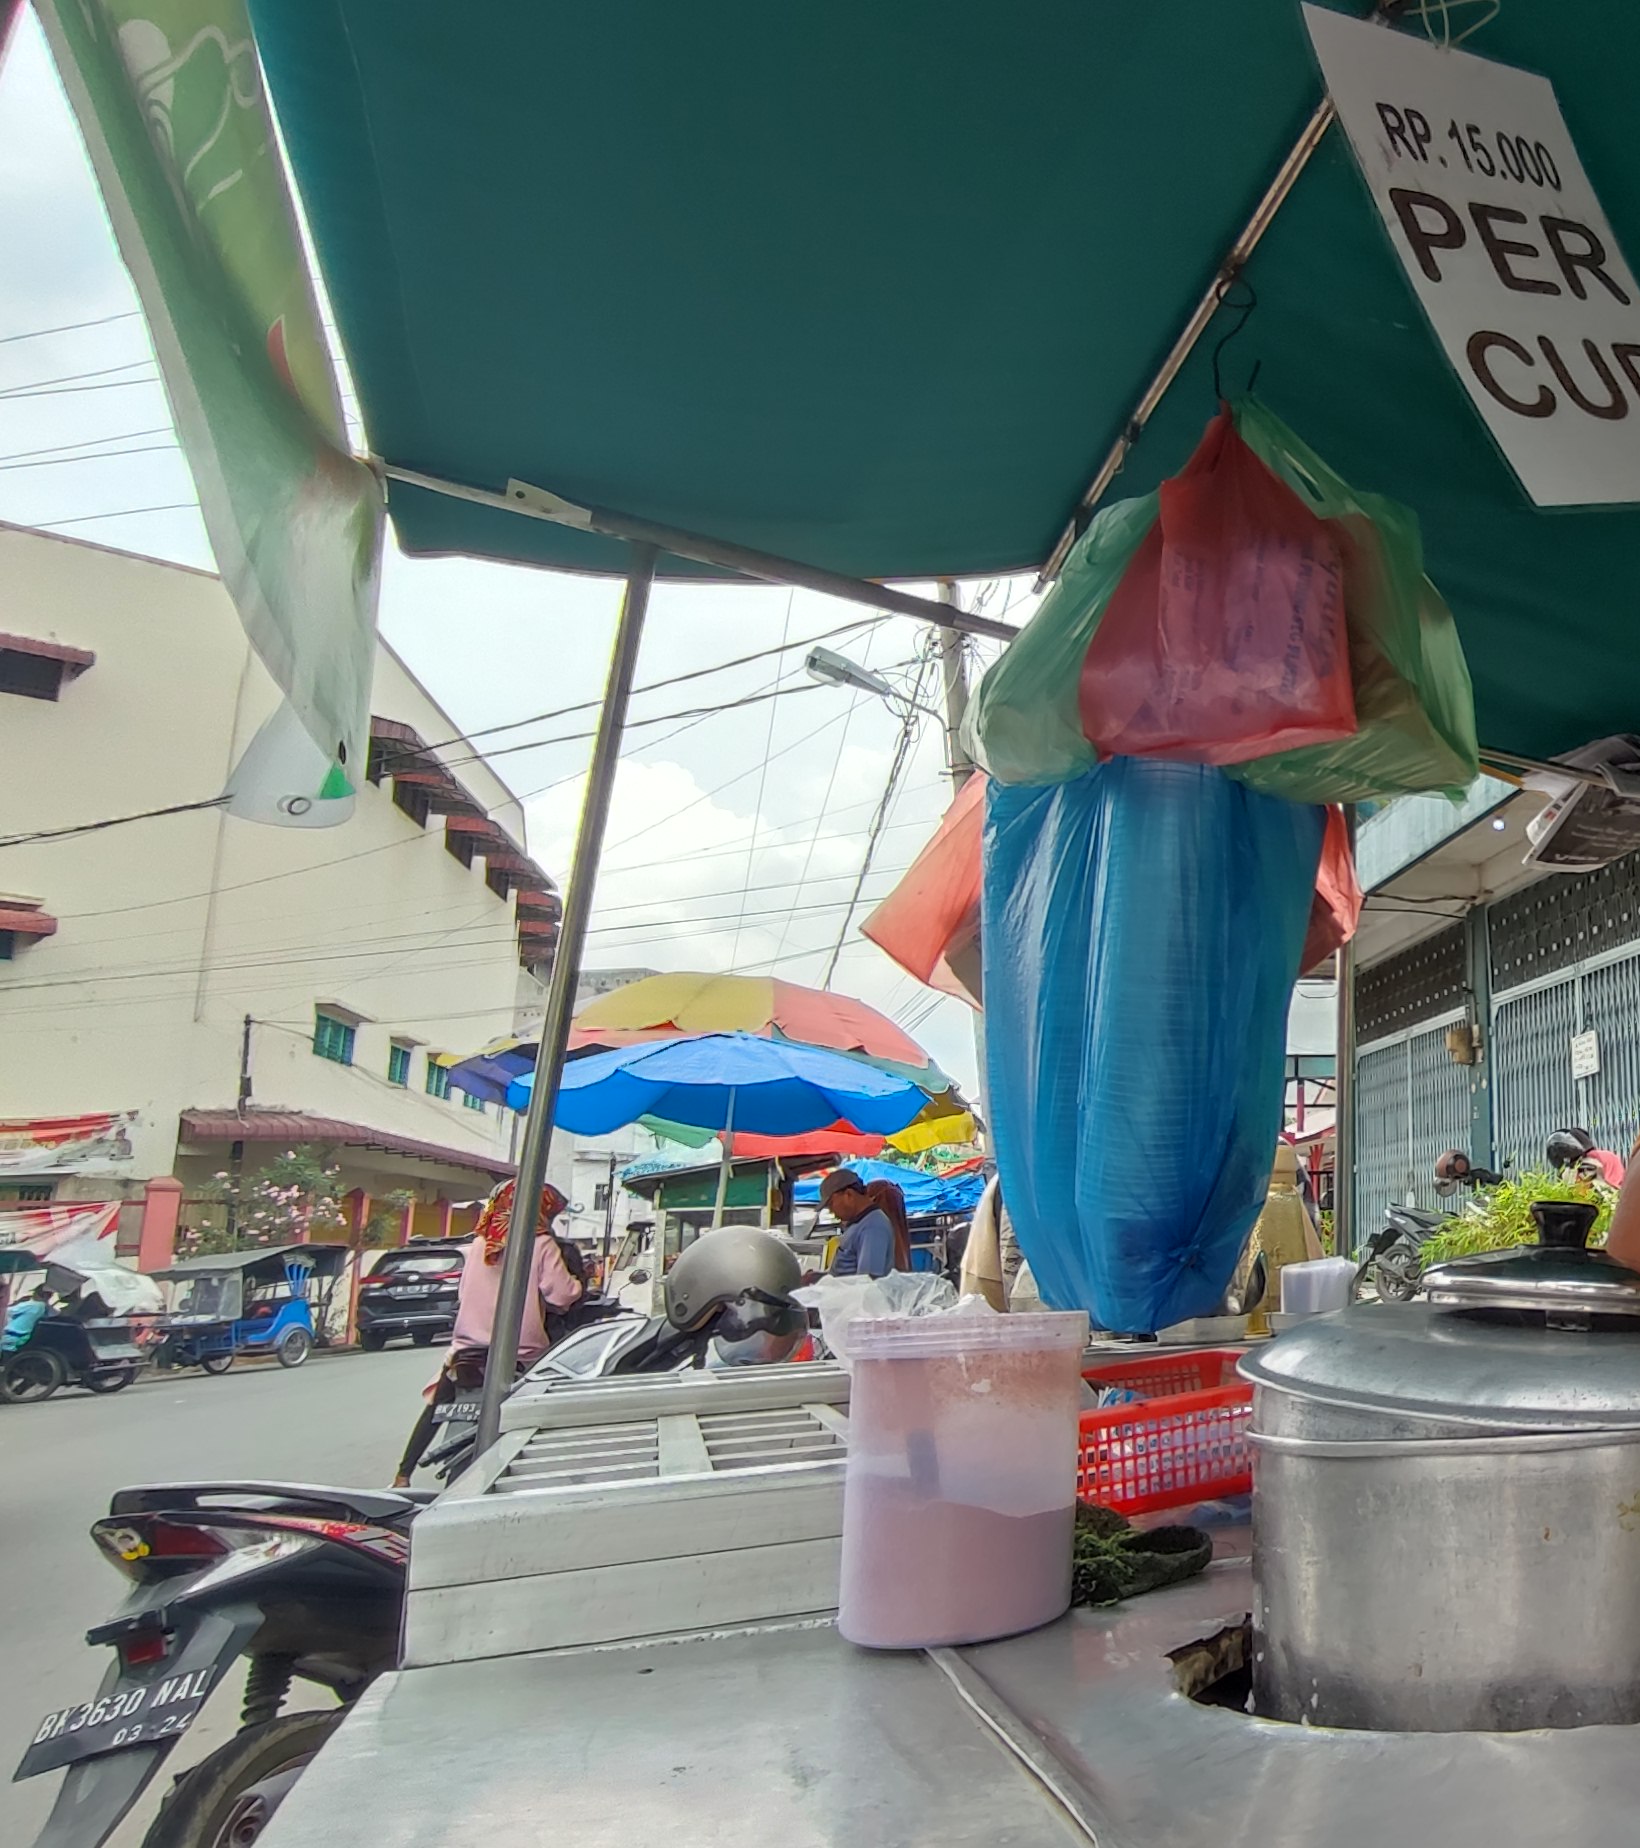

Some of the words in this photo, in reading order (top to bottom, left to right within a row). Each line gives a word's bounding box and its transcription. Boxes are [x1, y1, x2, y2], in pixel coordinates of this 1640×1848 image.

[1376, 102, 1447, 168] RP.
[1447, 119, 1562, 192] 15.000
[1389, 187, 1631, 306] PER
[34, 1707, 77, 1745] BK
[70, 1687, 147, 1732] 3630
[150, 1669, 207, 1709] NAL
[112, 1723, 143, 1746] 03
[160, 1711, 193, 1734] 24
